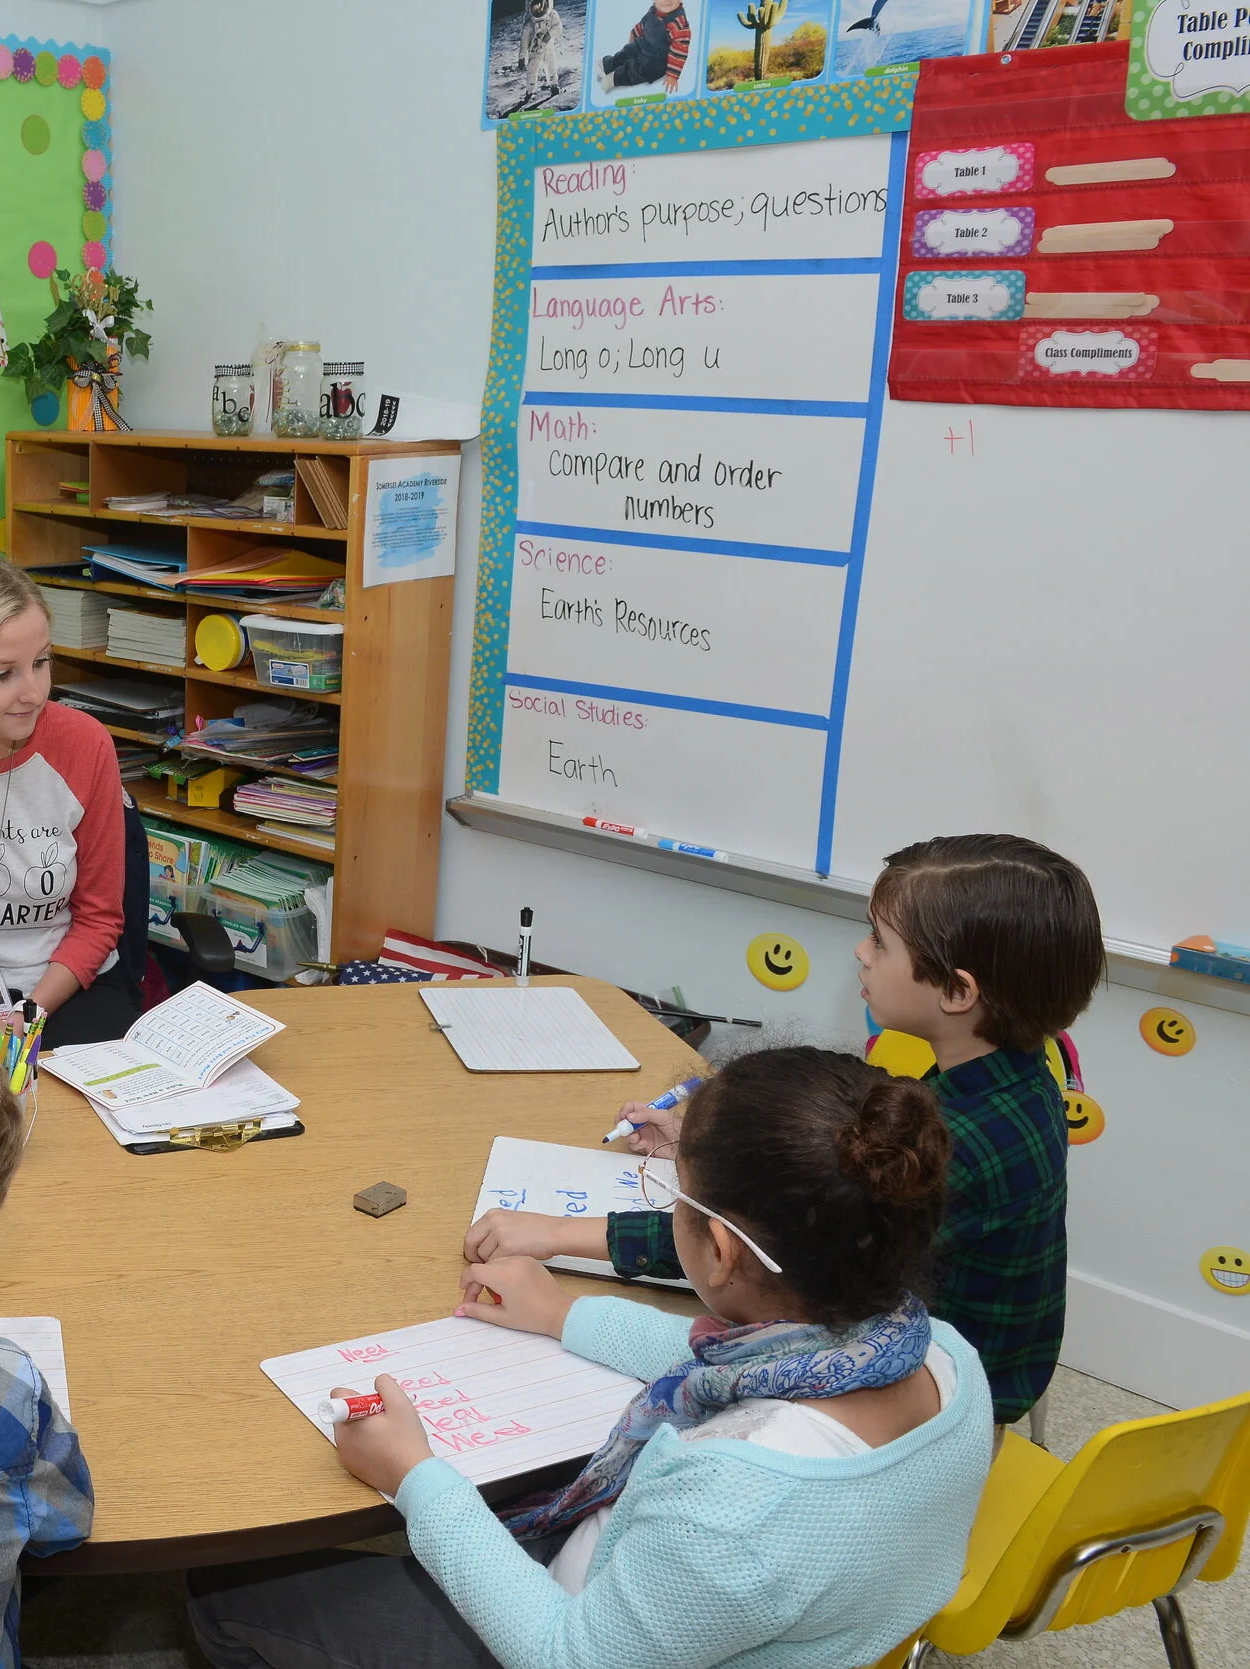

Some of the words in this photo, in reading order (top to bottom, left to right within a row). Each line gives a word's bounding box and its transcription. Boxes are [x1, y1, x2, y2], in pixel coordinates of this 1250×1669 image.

[1177, 11, 1228, 33] Table
[1234, 7, 1250, 28] P
[1183, 35, 1250, 61] Compli
[542, 162, 636, 198] Reading:
[954, 166, 978, 178] Table
[981, 166, 986, 176] 1
[542, 205, 630, 242] Author's
[641, 194, 745, 243] purpose;
[751, 183, 889, 231] questions
[954, 227, 978, 238] Table
[980, 227, 988, 238] 2
[532, 287, 645, 330] Language
[658, 285, 724, 317] Arts:
[946, 293, 970, 304] Table
[972, 293, 978, 303] 3
[539, 336, 589, 379] Long
[597, 348, 621, 374] o;
[628, 337, 685, 378] Long
[703, 345, 721, 369] u
[1045, 348, 1068, 358] Class
[1070, 348, 1132, 360] Compliments
[529, 410, 598, 442] Math:
[398, 480, 423, 488] ACADEMY
[424, 478, 448, 486] RIVERSIDE
[658, 453, 702, 484] and
[714, 460, 782, 491] order
[394, 492, 424, 502] 2018-2019
[624, 495, 714, 528] numbers
[519, 540, 614, 575] Science:
[541, 587, 603, 627] Earth's
[615, 598, 711, 651] Resources
[508, 690, 566, 718] Social
[577, 701, 648, 730] Studies:
[549, 740, 618, 787] Earth
[30, 826, 62, 838] are
[154, 852, 174, 864] Share
[337, 1344, 390, 1363] Need
[395, 1370, 450, 1391] eed
[416, 1389, 471, 1410] eed
[432, 1420, 531, 1452] Weed
